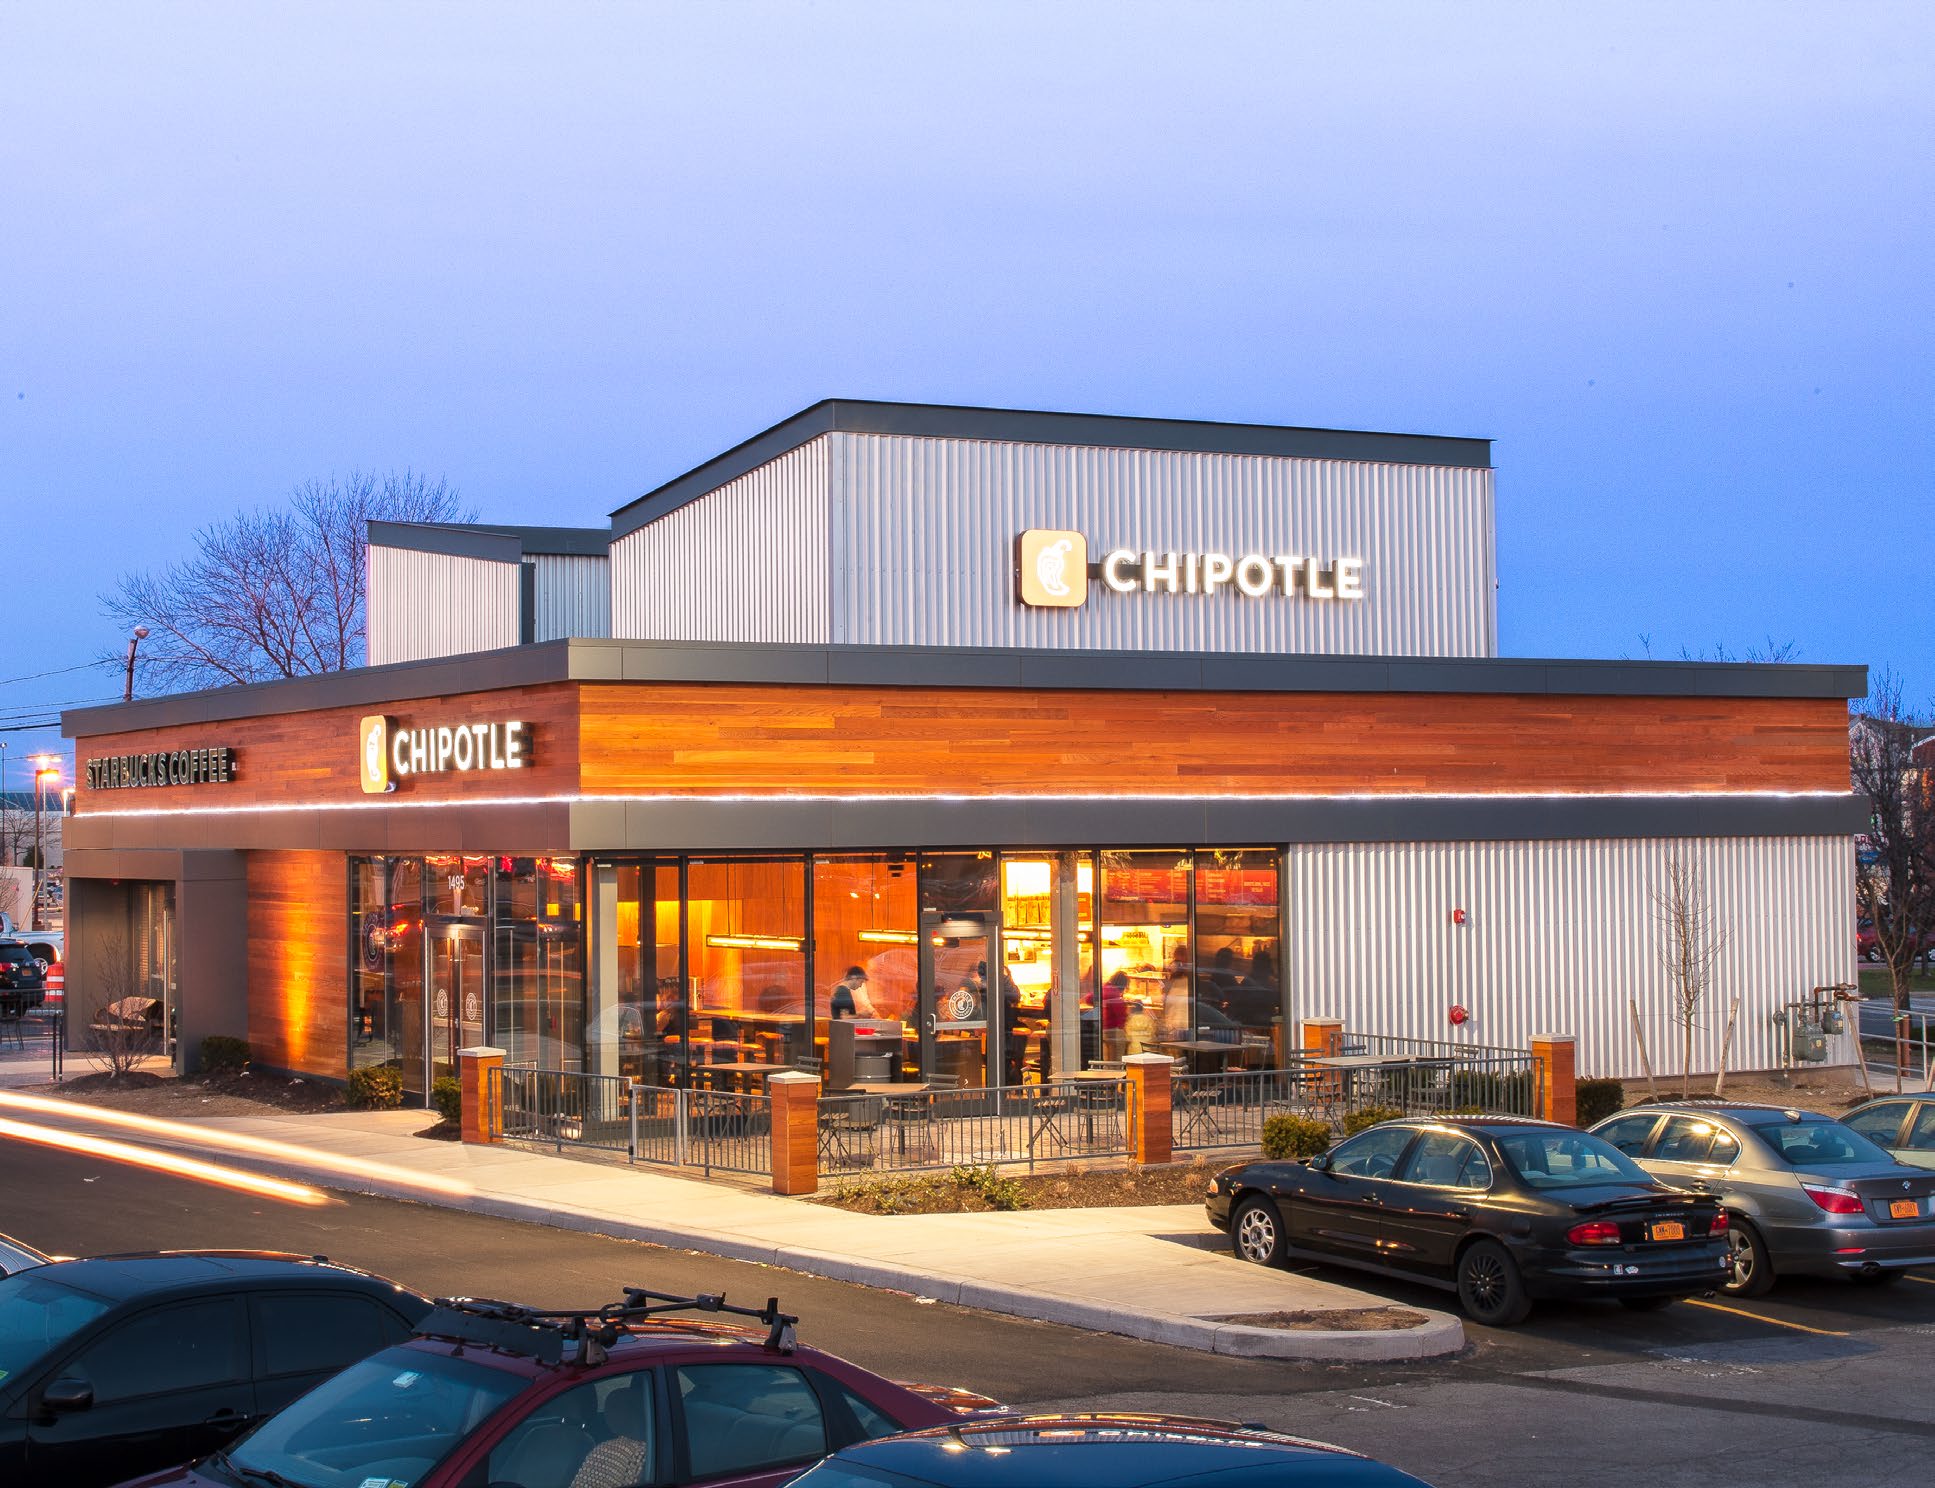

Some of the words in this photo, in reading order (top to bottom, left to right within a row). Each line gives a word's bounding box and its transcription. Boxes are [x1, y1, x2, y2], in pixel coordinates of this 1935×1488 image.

[1103, 549, 1364, 600] CHIPOTLE
[86, 752, 168, 790] STARBUCKS
[169, 747, 229, 786] COFFEE
[392, 721, 524, 775] CHIPOTLE
[447, 875, 465, 890] 1495
